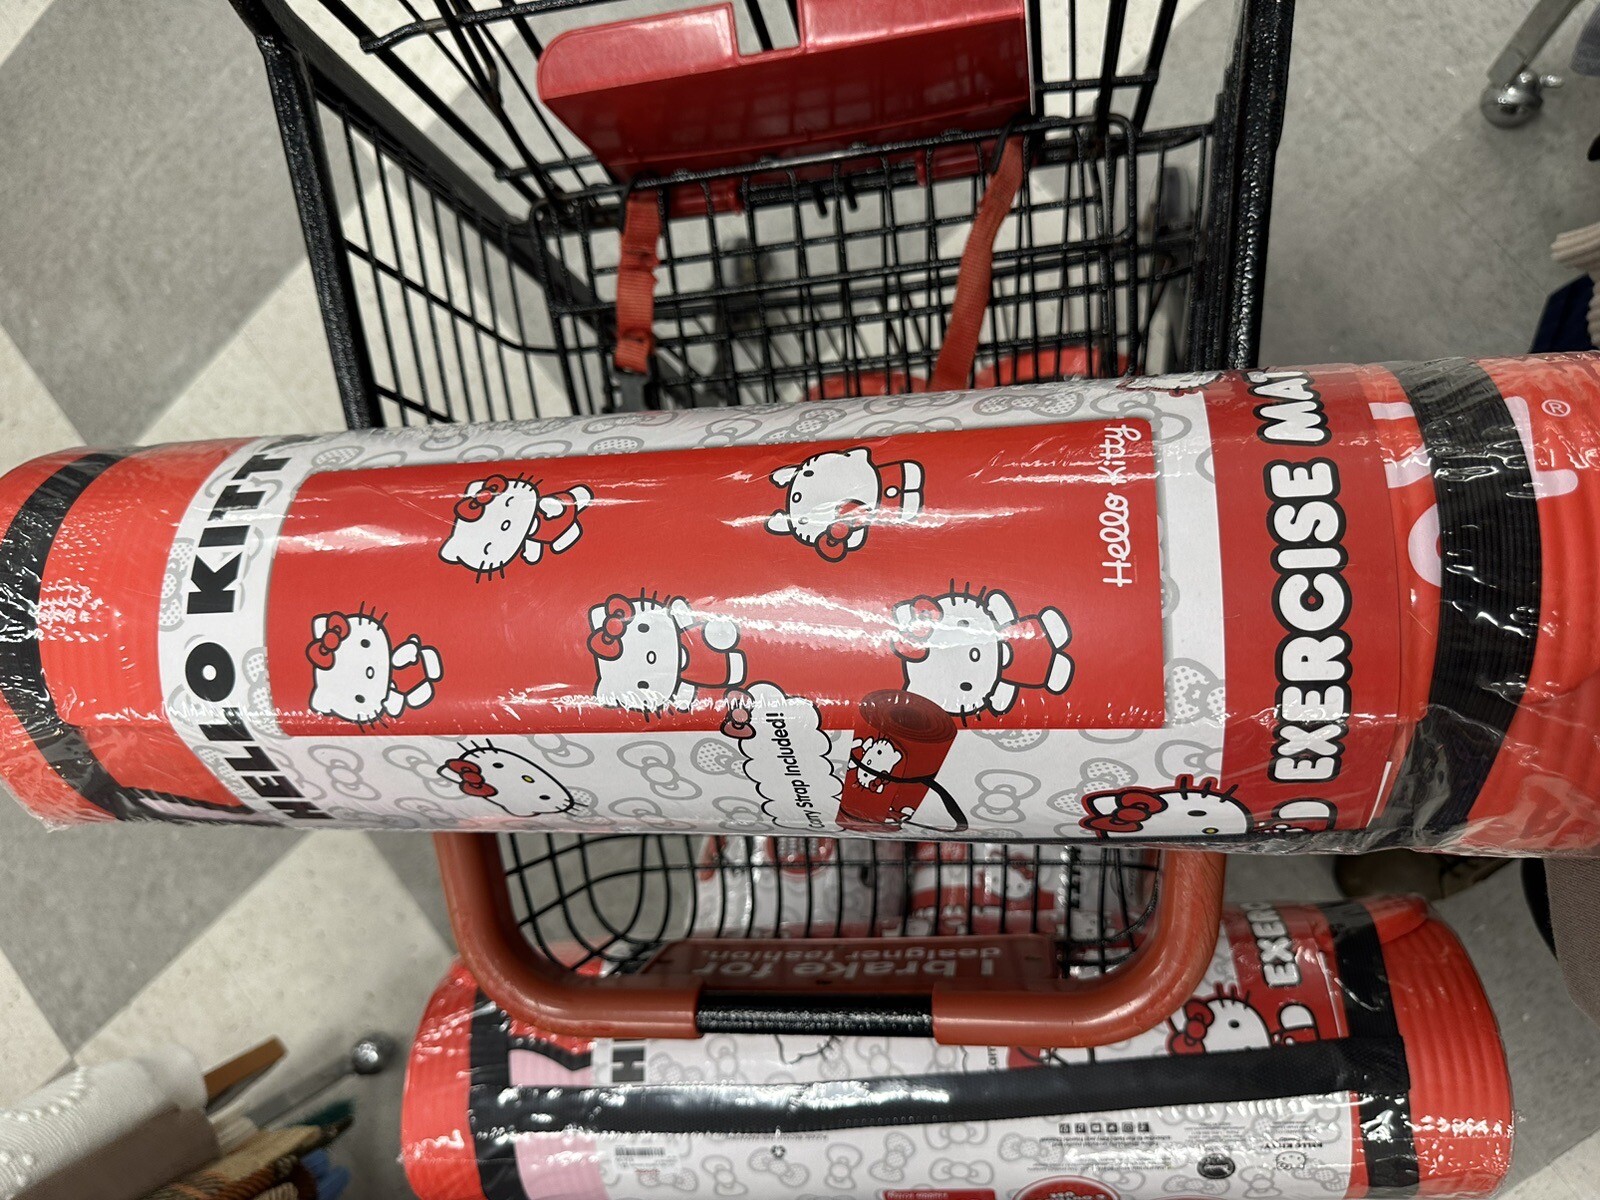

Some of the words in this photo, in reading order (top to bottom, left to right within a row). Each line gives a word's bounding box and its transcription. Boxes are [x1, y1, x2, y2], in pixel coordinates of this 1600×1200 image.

[1244, 371, 1329, 444] MAT
[1098, 424, 1142, 486] Kitty
[1099, 492, 1133, 588] Hello
[1267, 459, 1349, 782] EXERCISE
[184, 641, 336, 820] HELLO
[765, 712, 802, 776] Included!
[791, 779, 814, 808] Strap
[692, 959, 774, 978] for
[792, 959, 957, 979] brake
[846, 946, 1001, 962] designer
